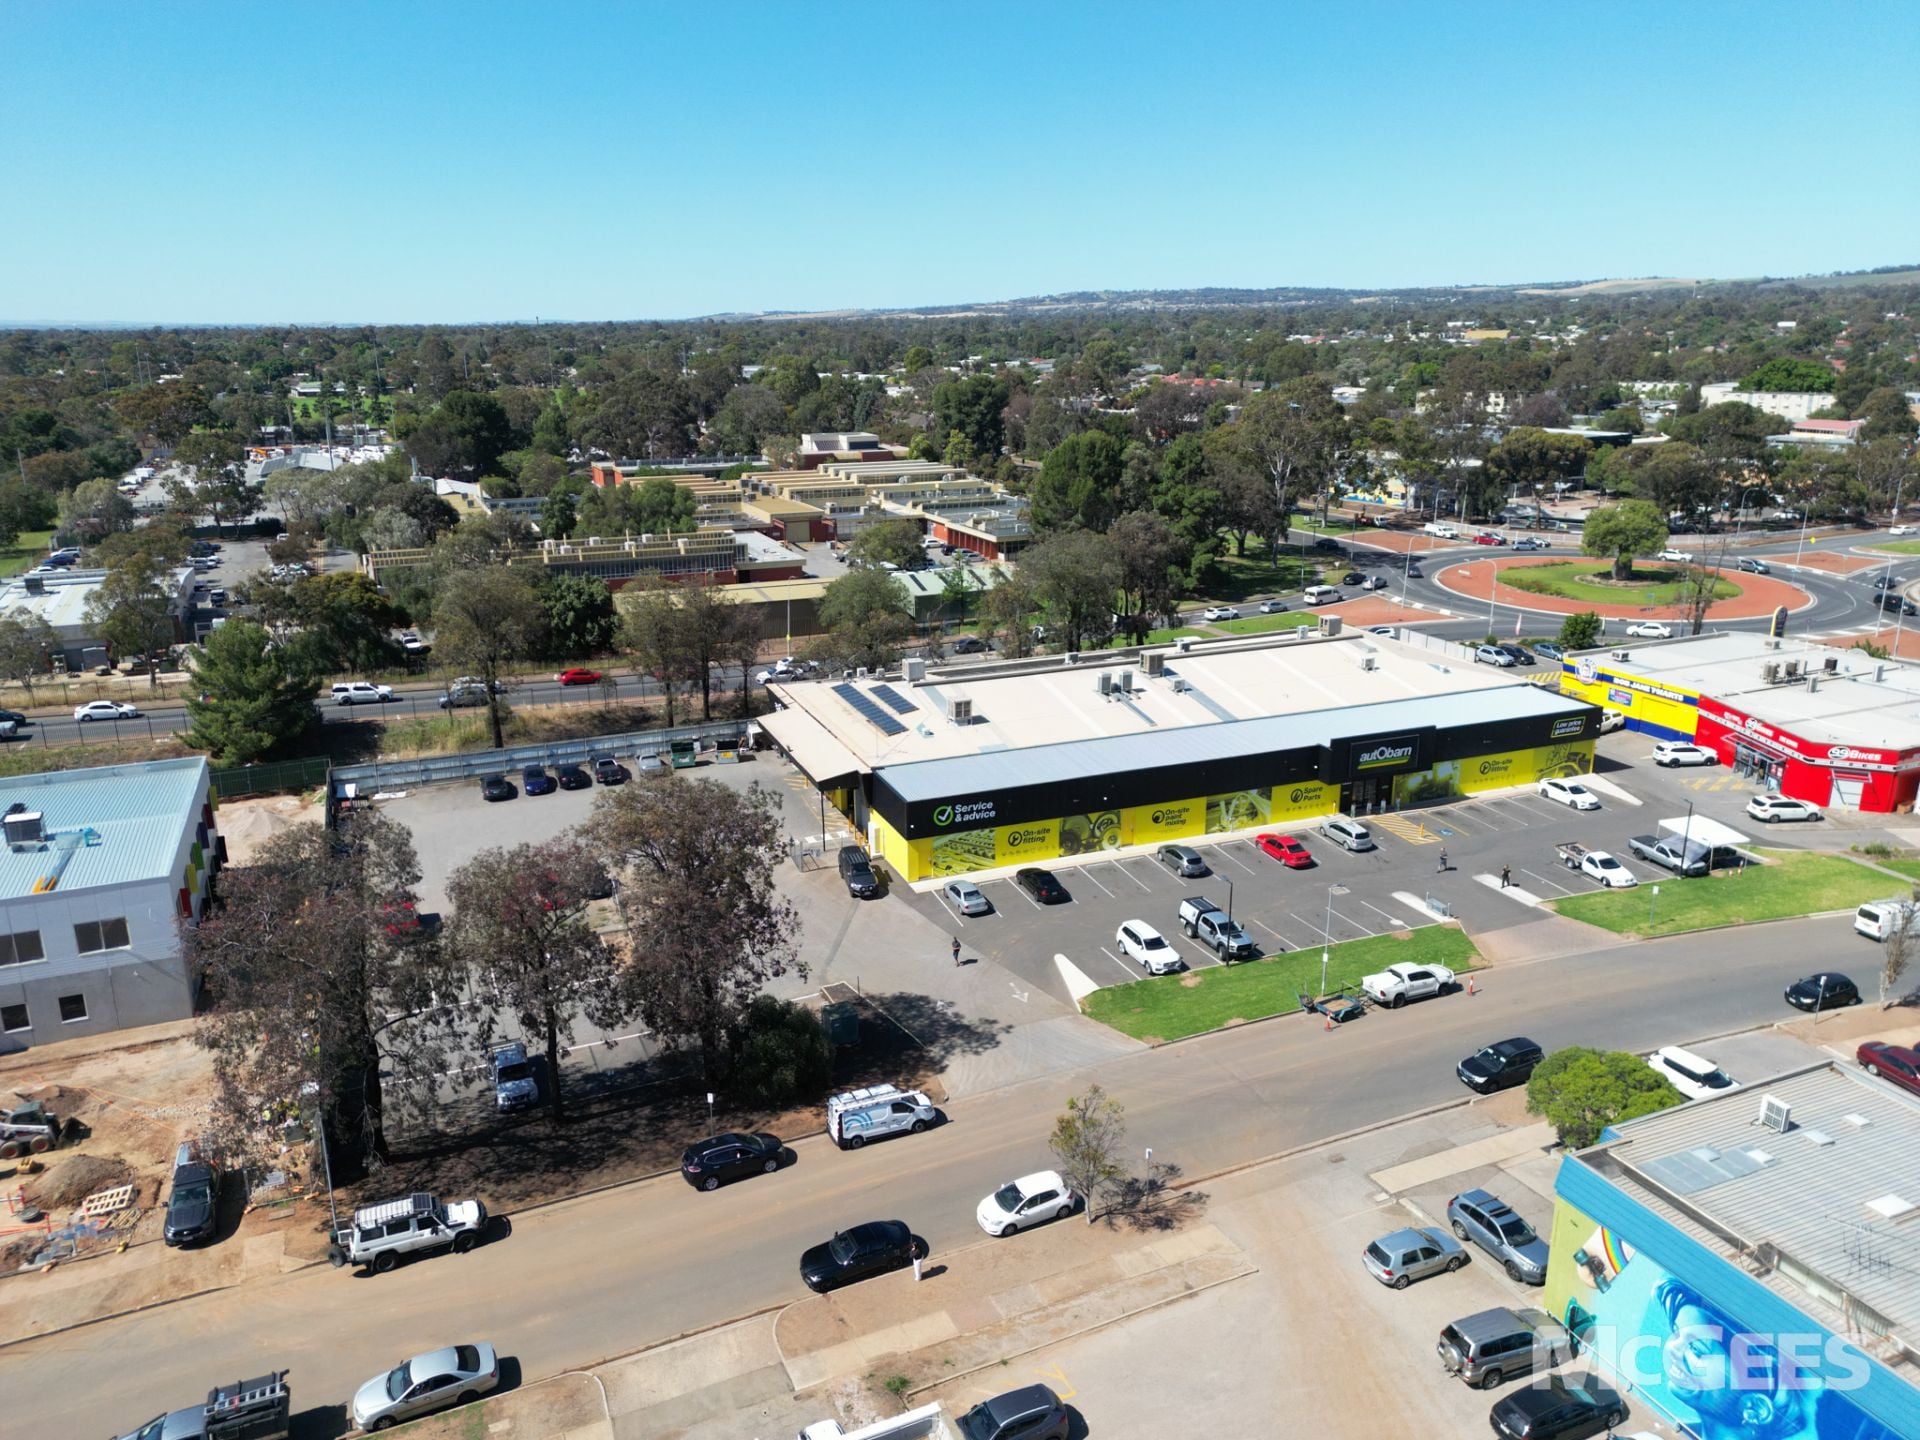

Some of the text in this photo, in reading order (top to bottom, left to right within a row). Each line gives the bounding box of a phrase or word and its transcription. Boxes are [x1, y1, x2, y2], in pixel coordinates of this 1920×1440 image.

[1556, 719, 1582, 729] Low price
[1555, 725, 1581, 736] guarantee
[1829, 747, 1850, 760] 99
[1491, 758, 1513, 767] On-site
[1304, 786, 1324, 795] Spare
[954, 801, 994, 814] Service
[1165, 807, 1190, 816] On-site
[954, 810, 997, 823] & advice
[1022, 827, 1051, 838] On-site
[1022, 835, 1046, 844] fitting
